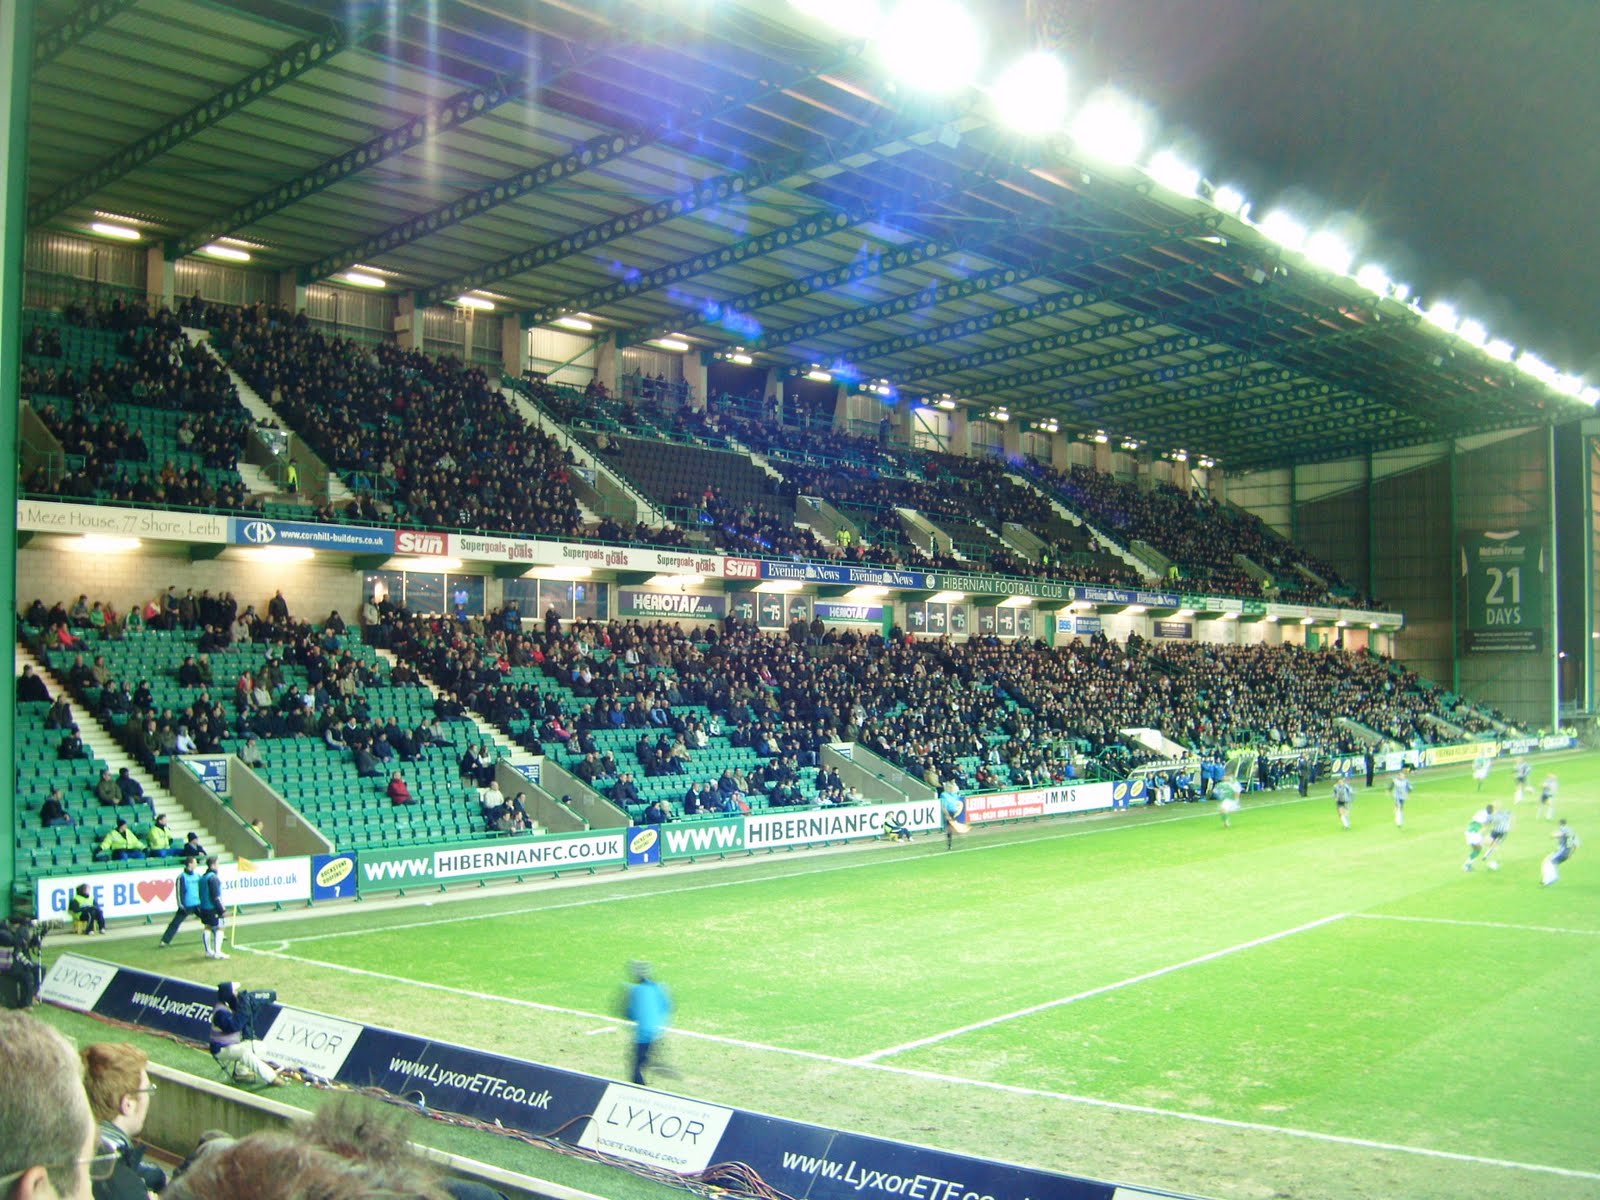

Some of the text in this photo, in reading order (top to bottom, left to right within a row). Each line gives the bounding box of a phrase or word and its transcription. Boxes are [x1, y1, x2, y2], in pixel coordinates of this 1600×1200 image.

[28, 508, 66, 525] Meze
[70, 512, 119, 530] House,
[123, 515, 138, 534] 77
[140, 513, 184, 536] Shore,
[188, 518, 221, 536] Leith
[280, 530, 384, 546] www.cornhill-builders.co.uk
[397, 532, 444, 554] Sun
[460, 538, 507, 553] Supergoals
[508, 543, 533, 559] goals
[562, 546, 604, 561] Supergoals
[605, 551, 629, 566] goals
[657, 554, 694, 568] Supergoals
[695, 558, 716, 573] goals
[725, 559, 757, 577] Sun
[768, 563, 840, 580] Evening News
[849, 569, 914, 585] Evening News
[942, 577, 1063, 598] HIBERNIAN FOOTBALL CLUB
[1485, 567, 1521, 604] 21
[743, 603, 753, 619] 75
[770, 604, 780, 620] 75
[1486, 607, 1521, 625] DAYS
[51, 885, 105, 912] GIE
[334, 885, 341, 898] 7
[53, 966, 102, 991] LYXOR
[276, 1023, 343, 1054] LYXOR
[388, 1055, 552, 1111] www.LyxorETF.co.uk
[606, 1102, 705, 1145] LYXOR
